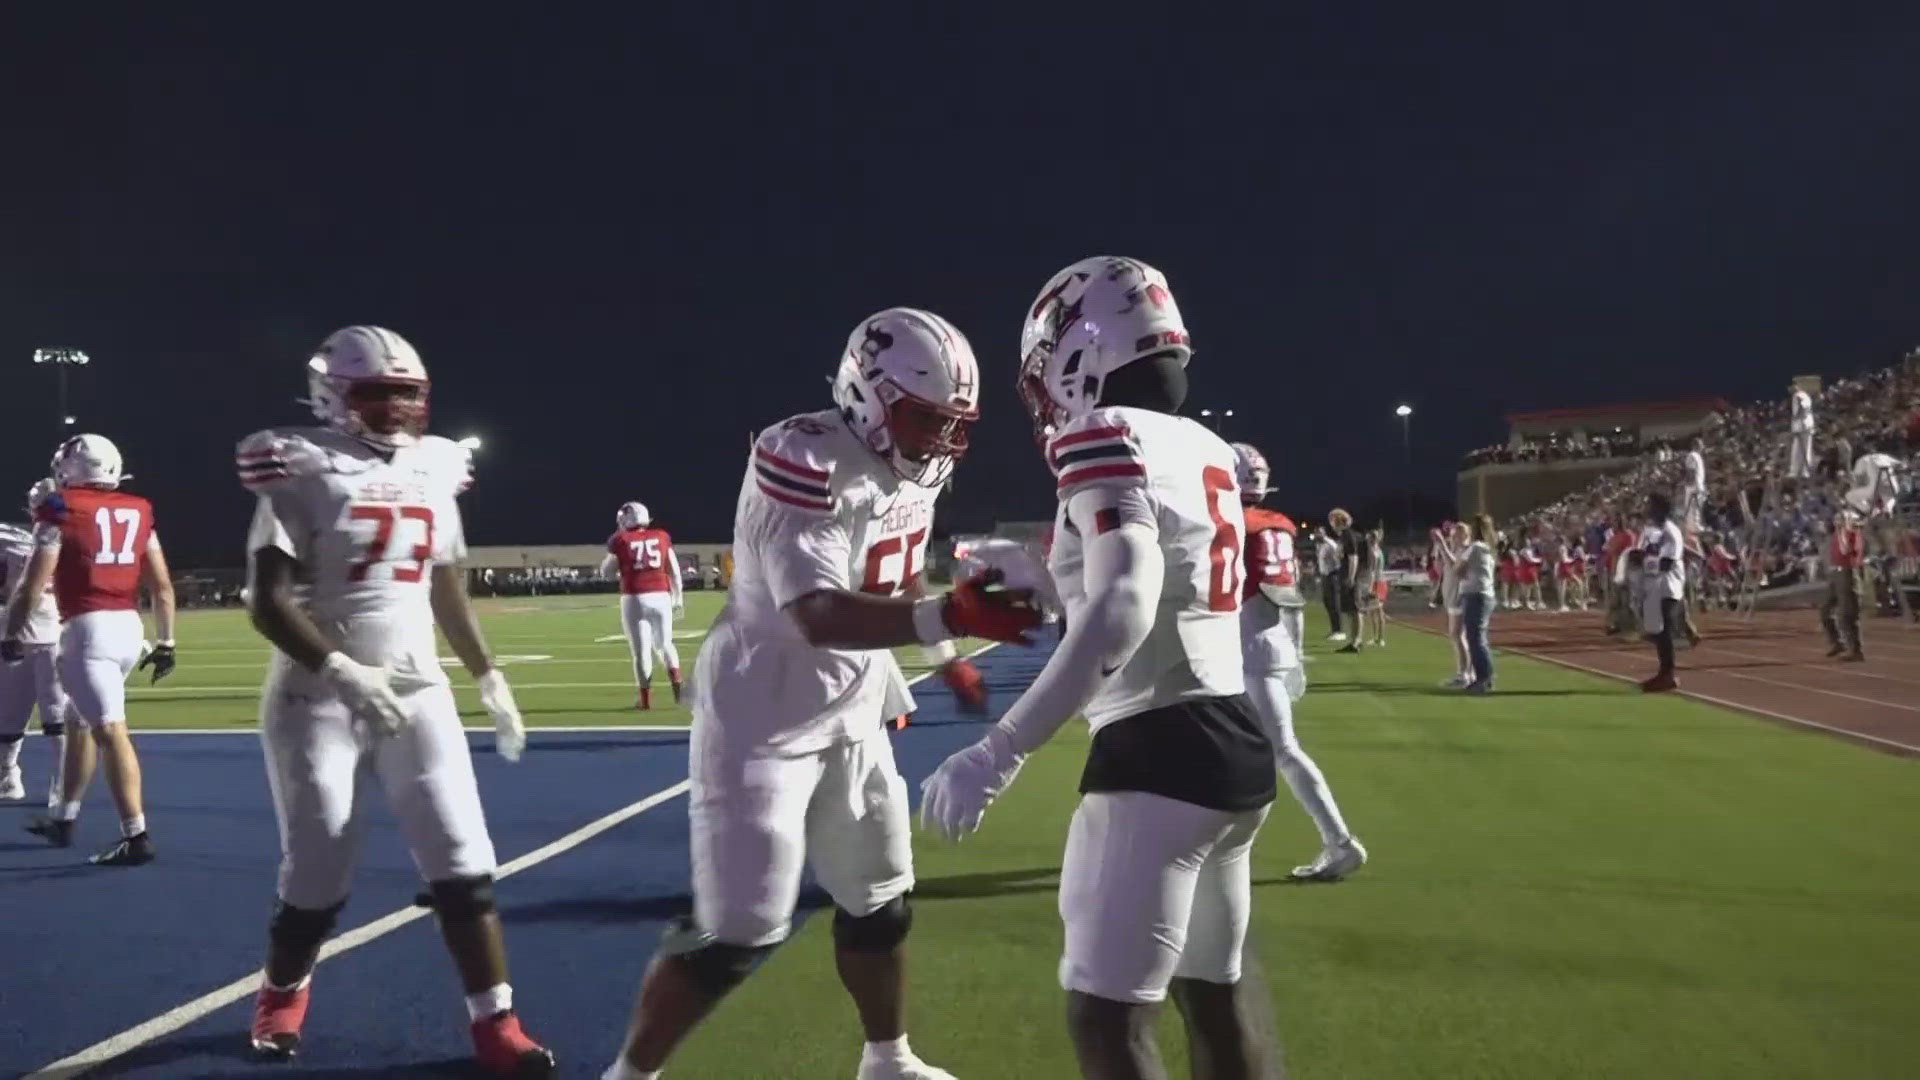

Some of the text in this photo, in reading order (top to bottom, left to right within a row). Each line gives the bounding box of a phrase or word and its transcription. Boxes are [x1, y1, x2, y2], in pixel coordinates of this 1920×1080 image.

[95, 507, 140, 564] 17
[347, 506, 434, 582] 73
[630, 538, 661, 570] 75
[1202, 464, 1240, 612] 6
